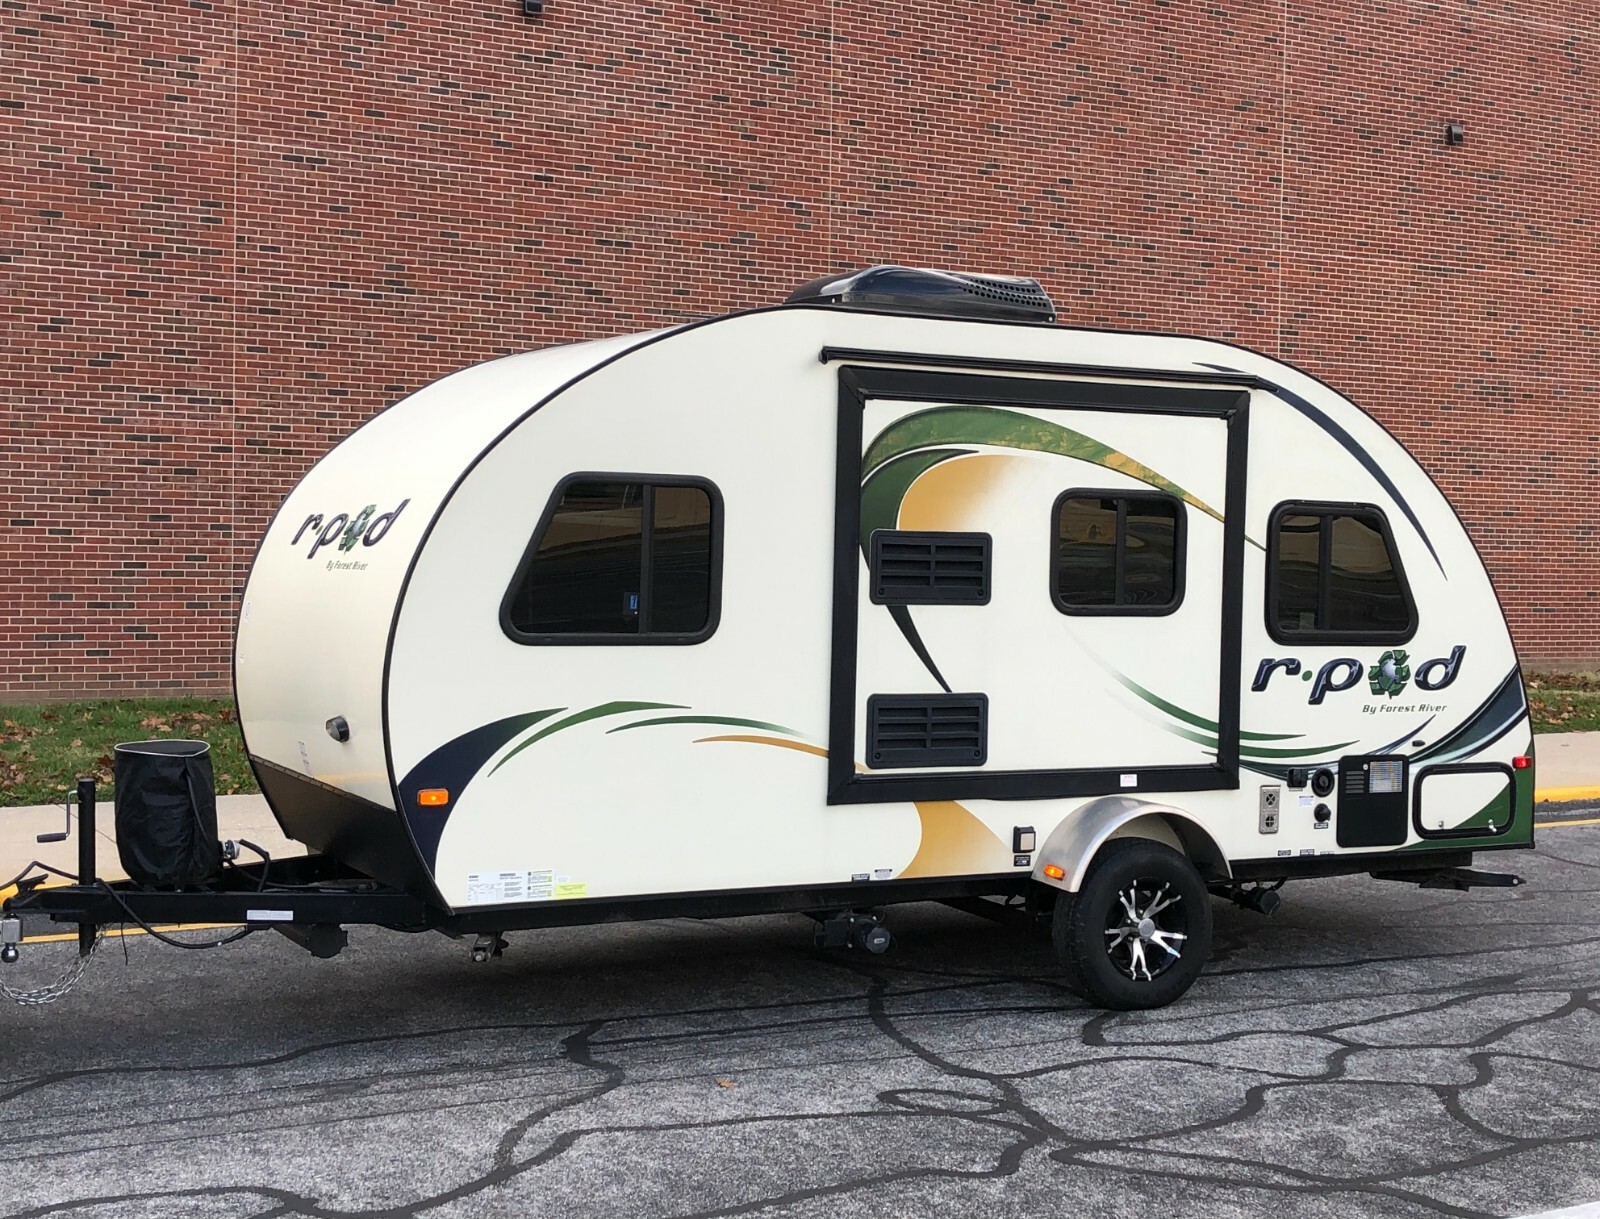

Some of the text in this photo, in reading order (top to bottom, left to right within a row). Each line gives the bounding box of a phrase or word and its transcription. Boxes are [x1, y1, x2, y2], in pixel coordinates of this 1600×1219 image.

[326, 560, 369, 571] By Forest River
[1362, 703, 1448, 715] By Forest River
